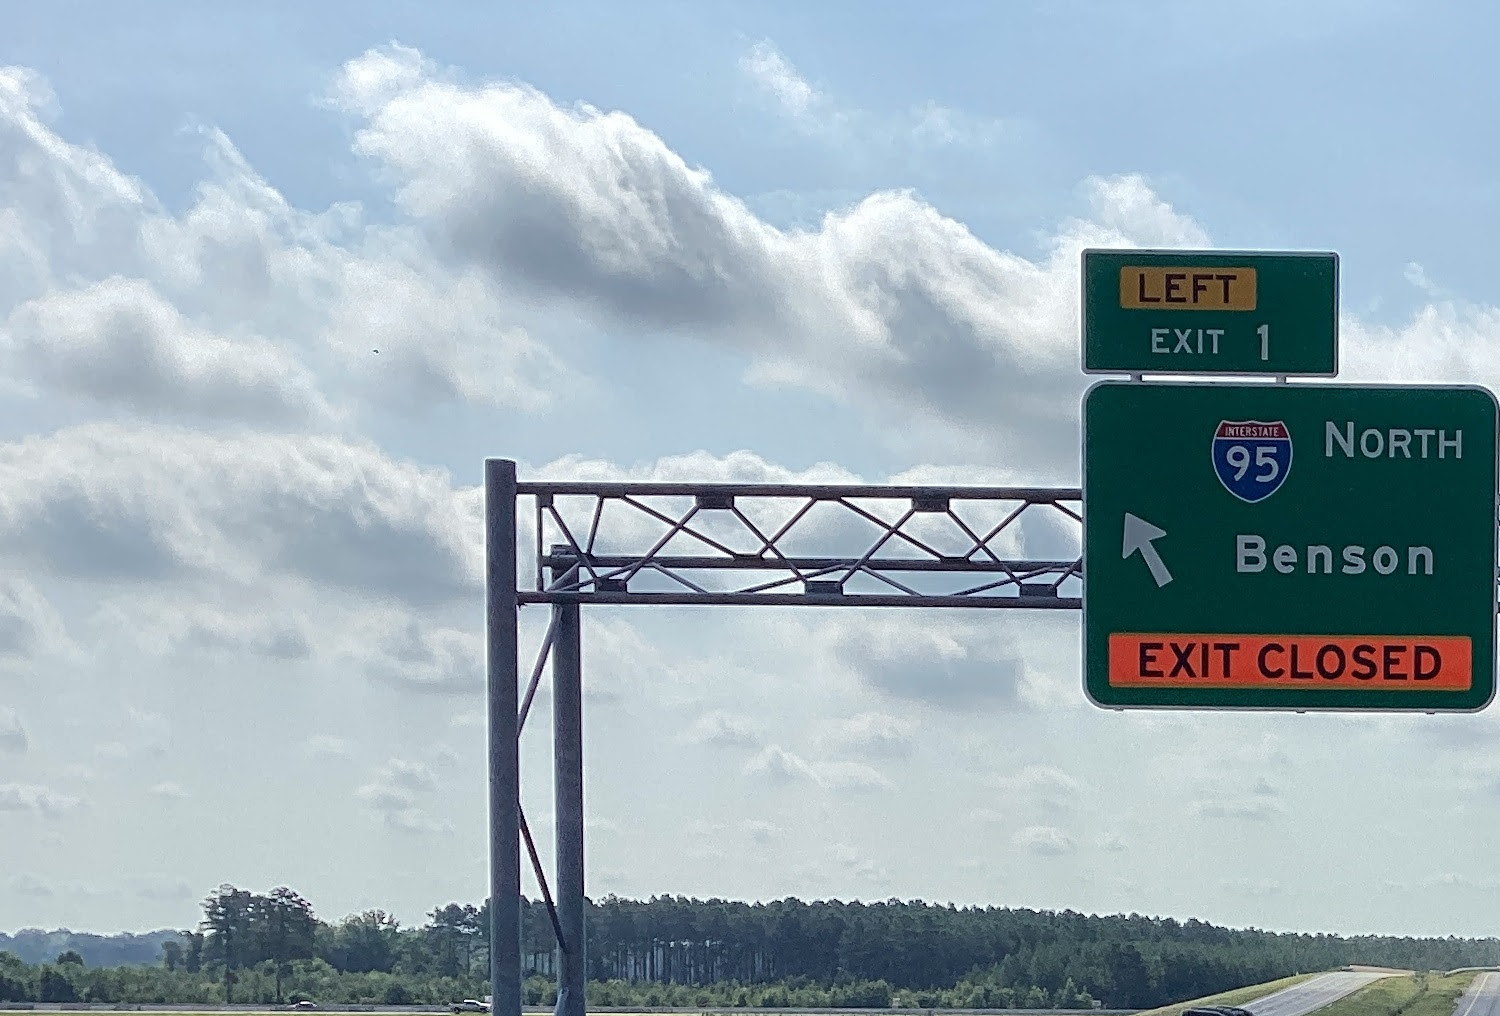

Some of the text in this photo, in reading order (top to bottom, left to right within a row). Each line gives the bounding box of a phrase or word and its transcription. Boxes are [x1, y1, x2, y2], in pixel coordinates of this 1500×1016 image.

[1137, 272, 1238, 304] LEFT
[1150, 323, 1271, 361] EXIT 1
[1225, 426, 1280, 437] INTERSTATE
[1324, 420, 1464, 460] NORTH
[1226, 445, 1280, 482] 95
[1235, 534, 1435, 576] Benson
[1138, 641, 1443, 682] EXIT CLOSED
